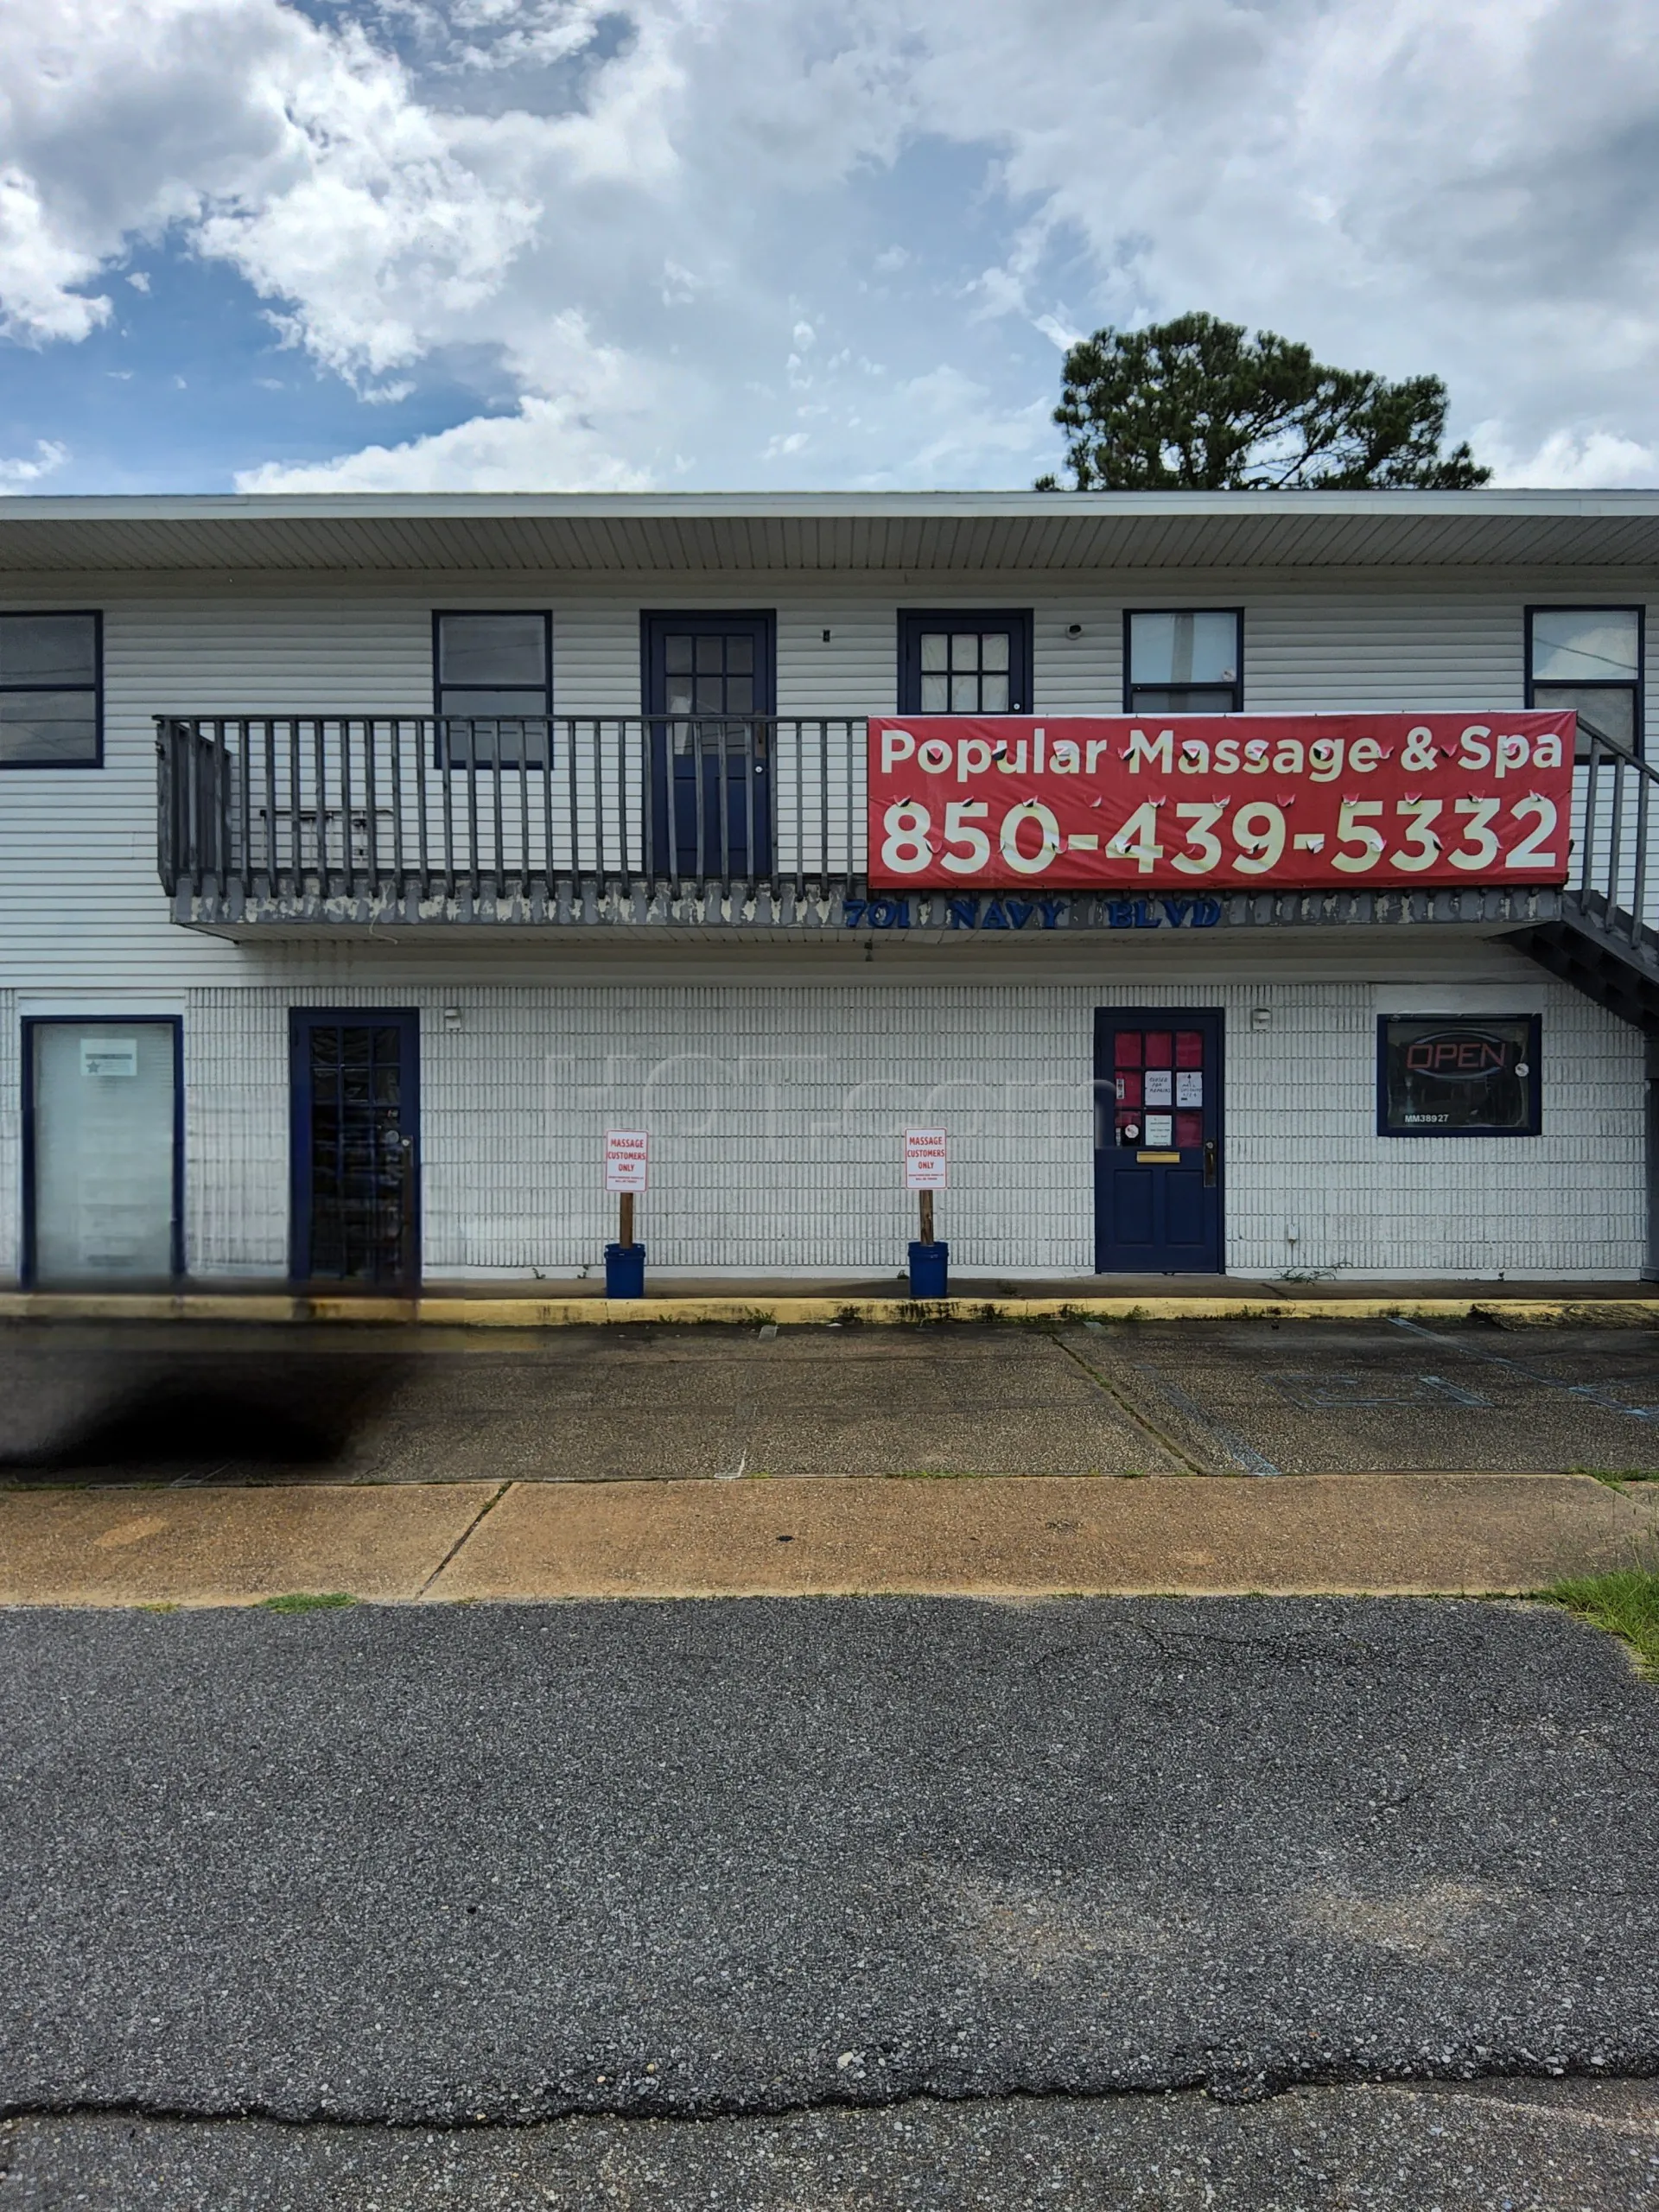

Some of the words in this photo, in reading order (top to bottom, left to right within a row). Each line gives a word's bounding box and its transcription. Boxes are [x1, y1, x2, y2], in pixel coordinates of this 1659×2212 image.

[880, 728, 1107, 783] Popular
[1128, 728, 1378, 783] Massage
[1400, 726, 1439, 772] &
[1457, 724, 1562, 779] Spa
[880, 798, 1558, 874] 850-439-5332
[842, 900, 910, 930] 701
[949, 900, 1071, 930] NAVY
[1109, 899, 1221, 929] BLVD
[1407, 1043, 1506, 1069] OPEN
[1405, 1114, 1449, 1122] MM38927
[611, 1138, 644, 1147] MASSAGE
[909, 1136, 943, 1146] MASSAGE
[607, 1151, 646, 1160] CUSTOMERS
[907, 1149, 944, 1158] CUSTOMERS
[619, 1163, 634, 1172] ONLY
[918, 1160, 934, 1169] ONLY
